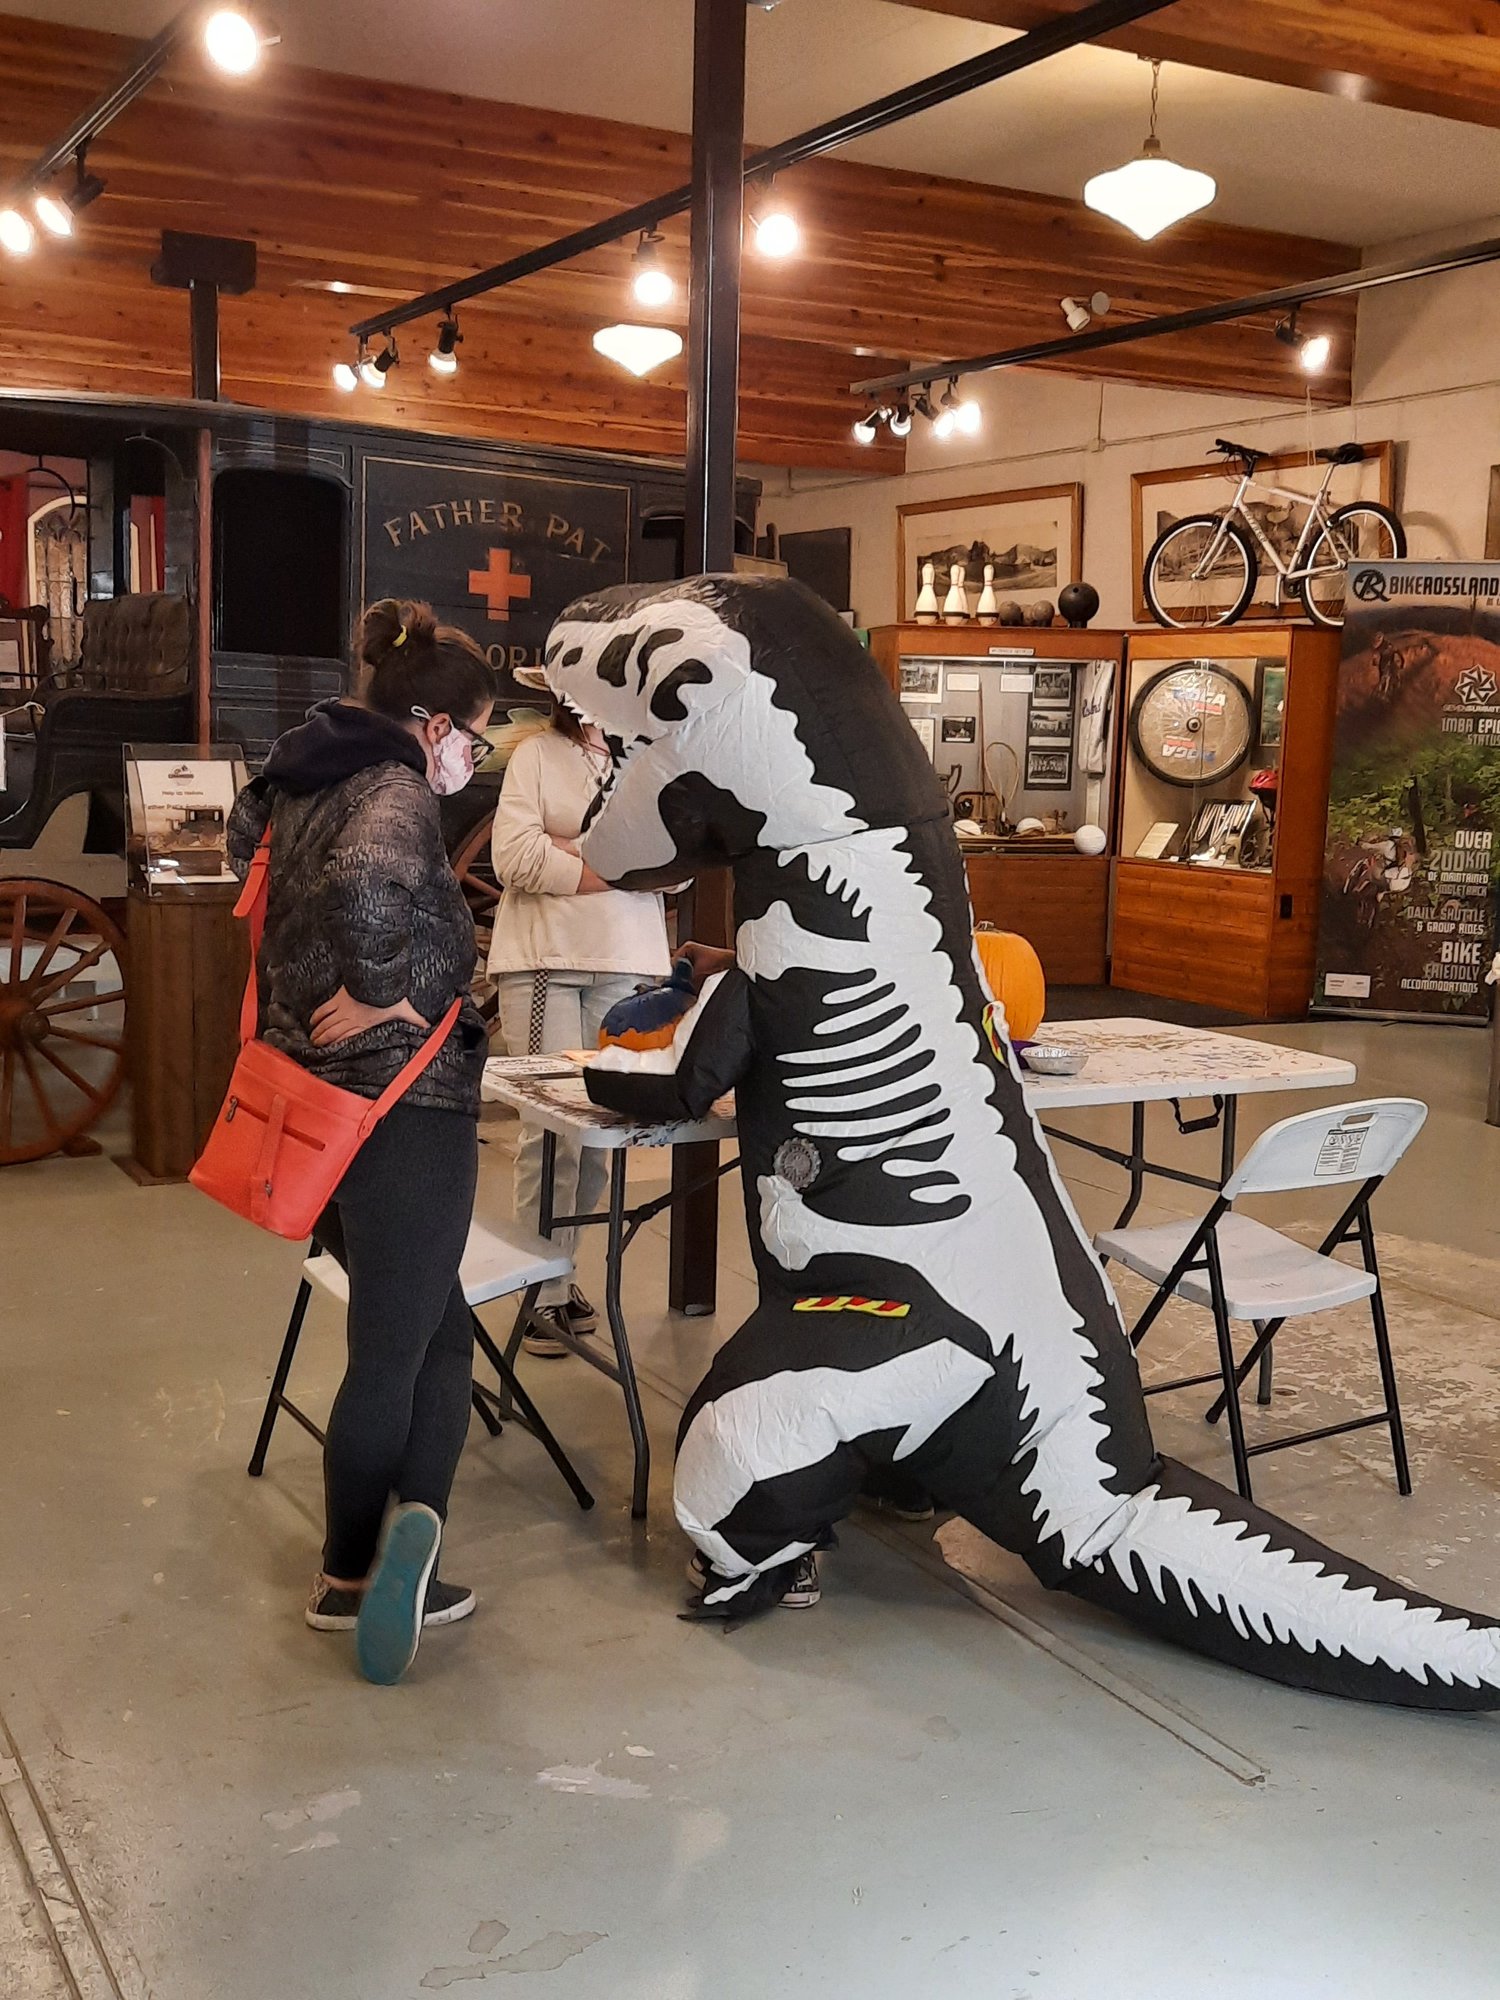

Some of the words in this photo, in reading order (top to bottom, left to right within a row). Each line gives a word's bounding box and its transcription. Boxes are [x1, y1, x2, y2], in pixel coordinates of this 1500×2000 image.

[383, 499, 523, 548] FATHER
[546, 512, 612, 564] PAT
[1441, 717, 1474, 732] IMBA
[1455, 830, 1492, 849] OVER
[1429, 850, 1490, 872] 200KM
[1427, 871, 1439, 882] OF
[1440, 872, 1489, 884] MAINTAINED
[1407, 906, 1439, 919] DAILY
[1440, 908, 1486, 923] SHUTTLE
[1426, 922, 1456, 933] GROUP
[1458, 923, 1484, 935] RIDES
[1441, 940, 1482, 965] BIKE
[1425, 963, 1480, 980] FRIENDLY
[1400, 978, 1479, 993] ACCOMMODATIONS
